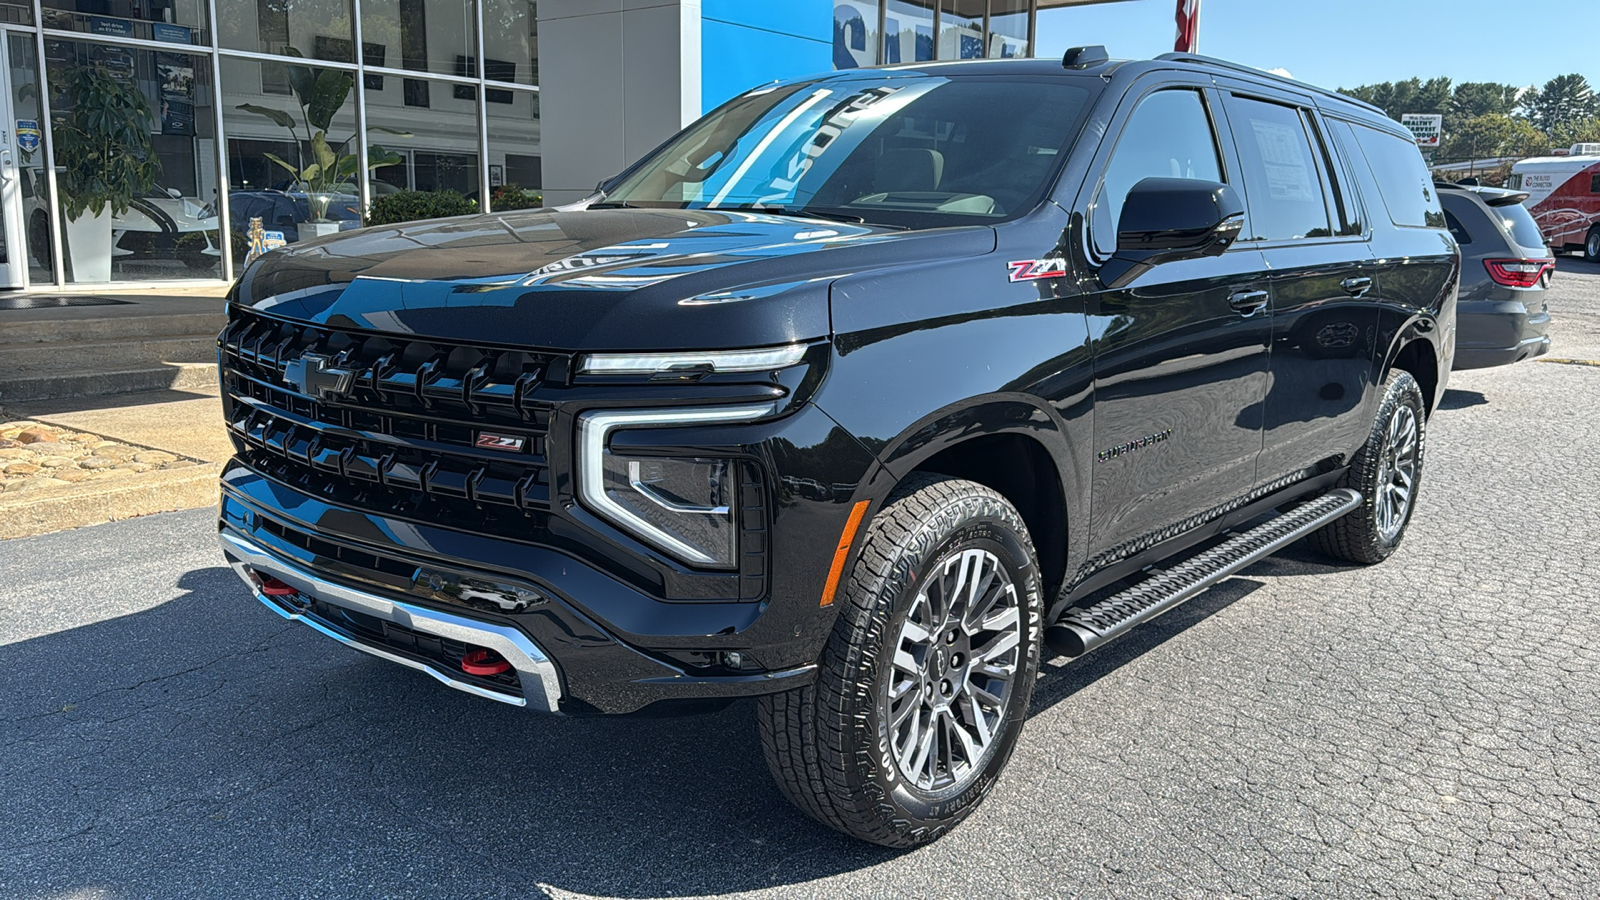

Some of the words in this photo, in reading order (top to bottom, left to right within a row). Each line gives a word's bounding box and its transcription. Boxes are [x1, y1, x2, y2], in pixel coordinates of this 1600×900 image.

[1006, 258, 1066, 283] Z71
[477, 434, 523, 450] Z71
[1098, 427, 1172, 463] SUBURBAN
